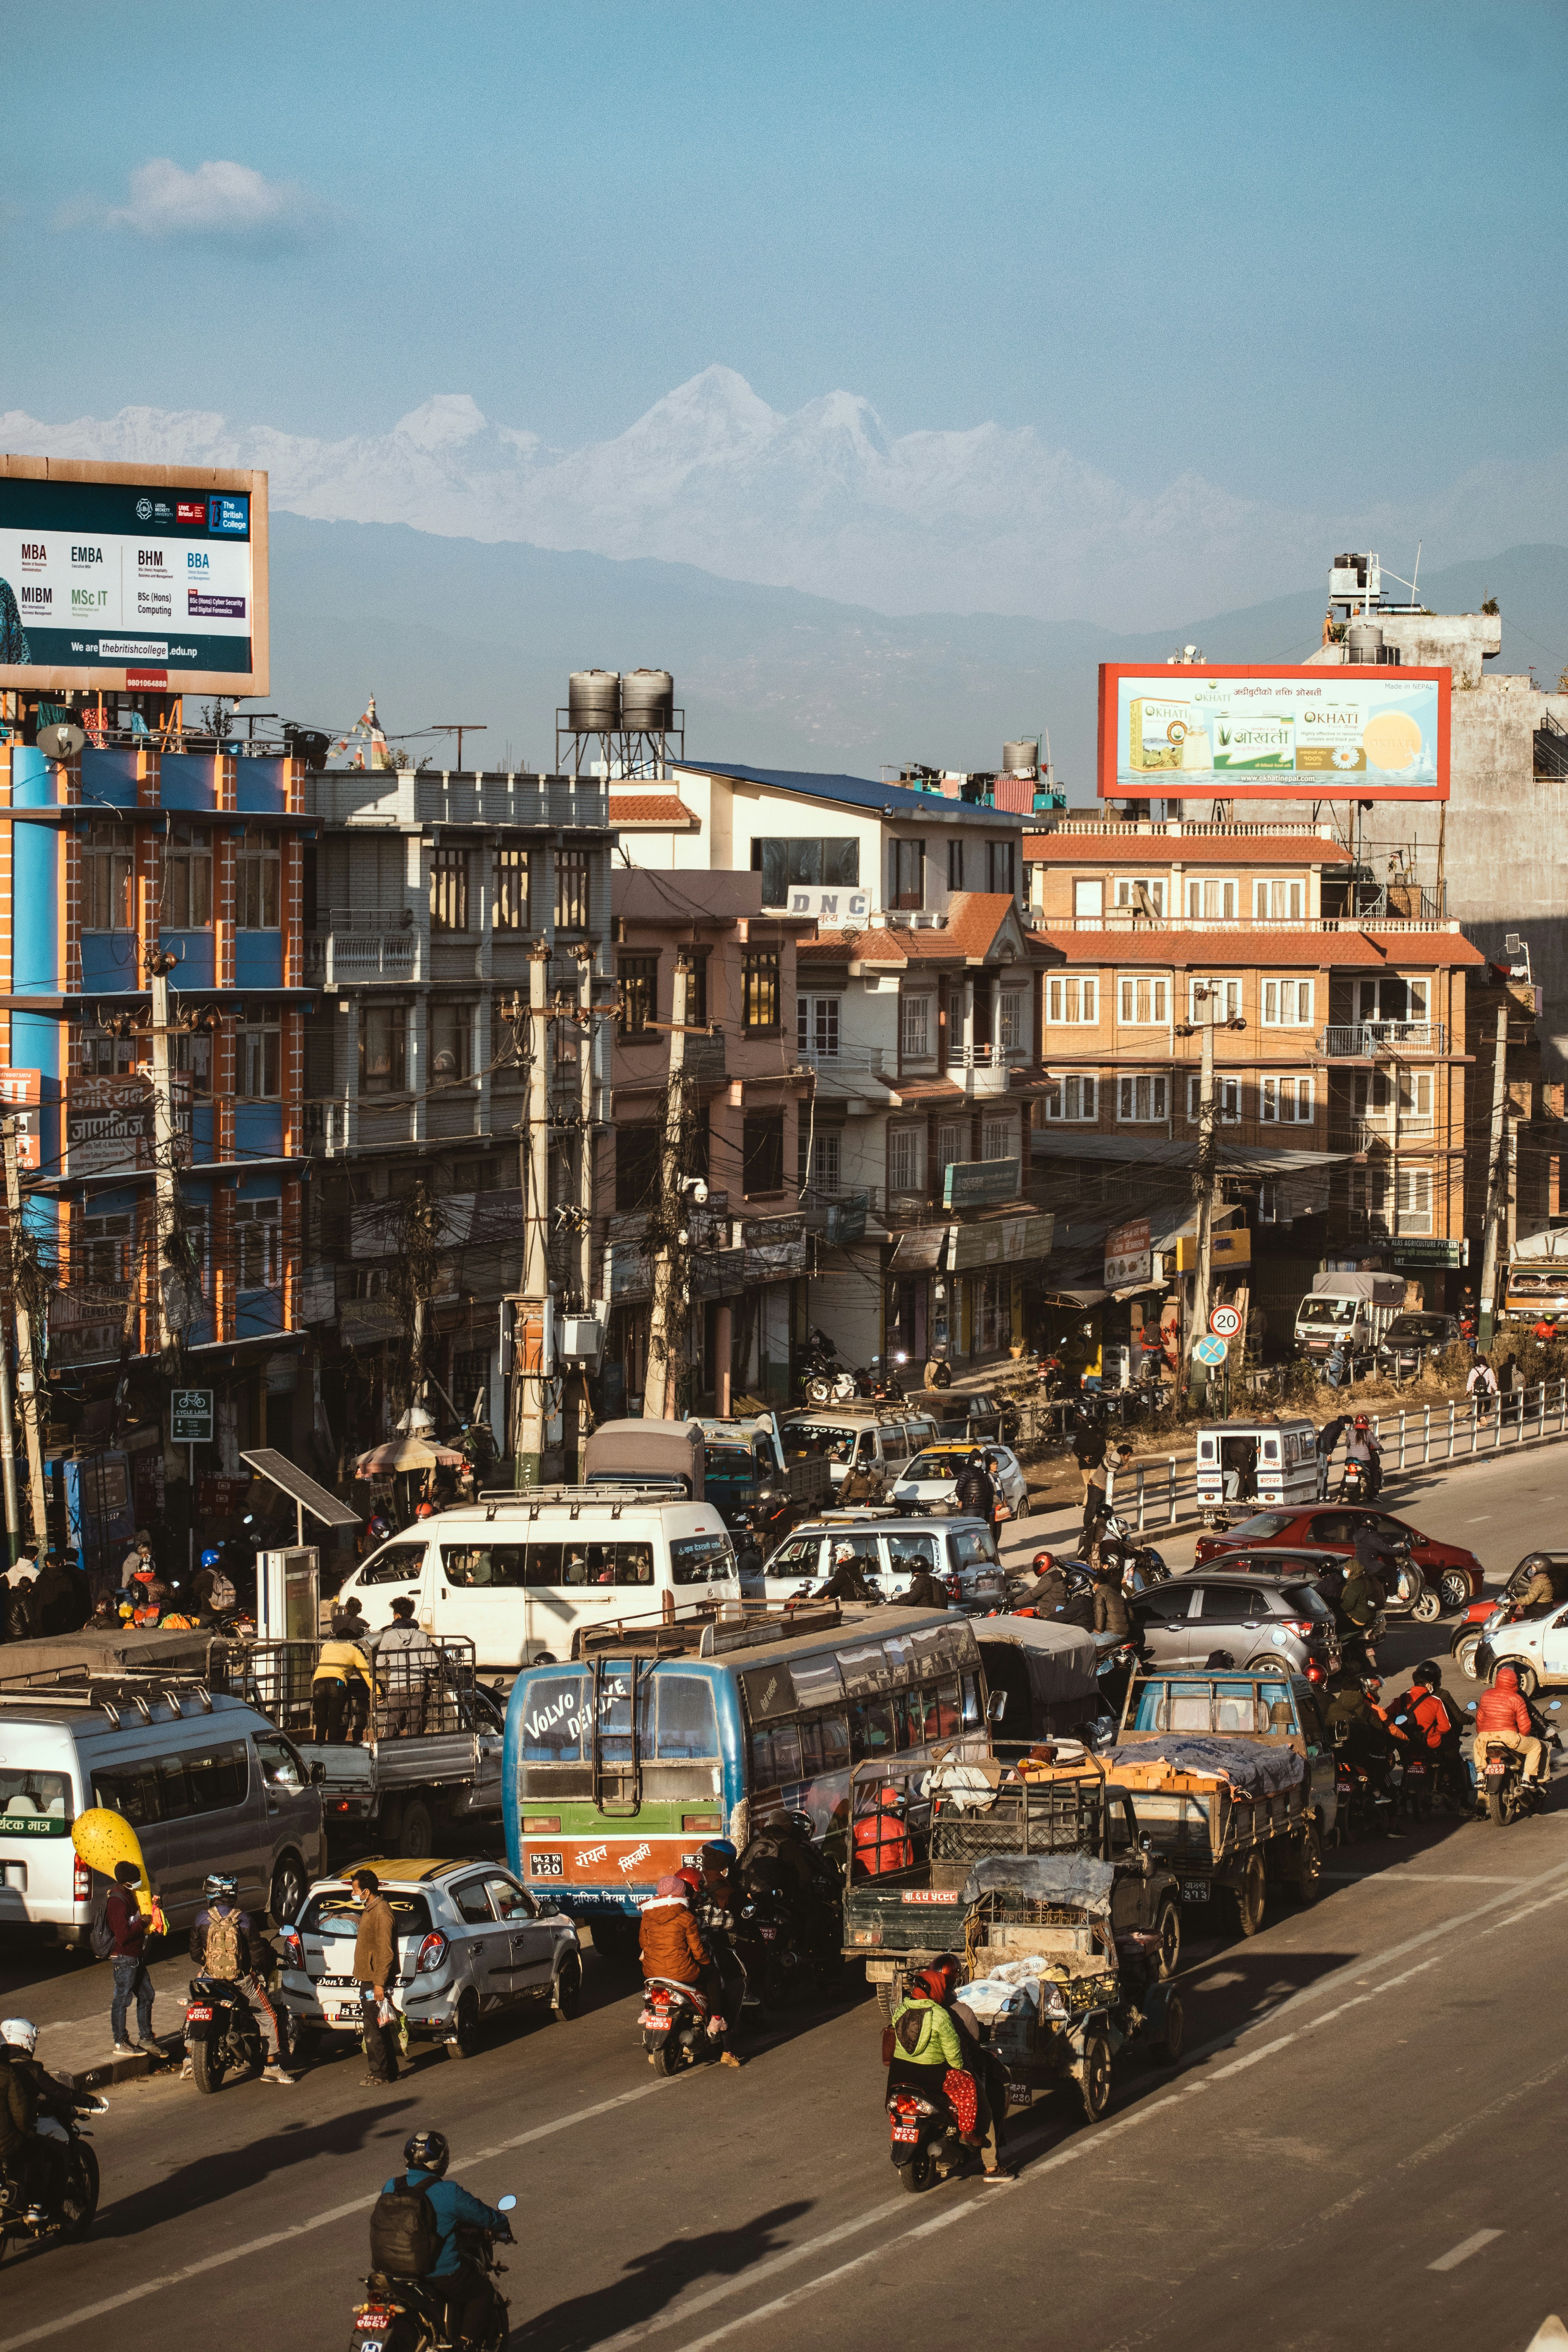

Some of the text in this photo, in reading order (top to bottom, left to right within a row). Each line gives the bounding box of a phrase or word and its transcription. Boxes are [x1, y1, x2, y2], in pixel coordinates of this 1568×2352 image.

[223, 501, 234, 509] The
[223, 520, 246, 530] College
[22, 544, 47, 560] MBA
[71, 546, 103, 563] EMBA
[138, 550, 163, 566] BHM
[187, 553, 209, 568] BBA
[22, 587, 52, 603] MIBM
[72, 589, 108, 606] MSc IT
[138, 592, 171, 603] BSc (Hons)
[138, 605, 171, 617] Computing
[198, 606, 212, 614] Digital
[71, 642, 98, 652] We are
[102, 643, 198, 658] thebritishcollege .edu.np
[127, 679, 167, 688] 9801064888
[1195, 693, 1230, 702] OKHATI
[1275, 687, 1293, 696] शक्ति
[1296, 688, 1321, 696] ओखती
[1145, 706, 1187, 718] OKHATI
[1304, 711, 1358, 724] OKHATI
[1234, 728, 1289, 744] ओखती
[1370, 739, 1414, 748] OKHATI
[1240, 774, 1315, 783] www.okhatinepal.com
[792, 895, 865, 914] D N C
[817, 915, 838, 924] नृत्य
[71, 1110, 145, 1140] जापानिज
[1218, 1315, 1236, 1328] 20
[797, 1426, 843, 1435] TOYOTA
[568, 1679, 626, 1740] DELUXE
[524, 1694, 573, 1739] VOLVO
[0, 1817, 51, 1831] र्यटक मात्र
[575, 1844, 608, 1867] रोयल
[537, 1864, 560, 1875] 120
[601, 1890, 625, 1904] नियम
[1184, 1890, 1207, 1900] ३१३
[316, 1977, 344, 1986] Don't
[895, 2133, 915, 2141] ५६२
